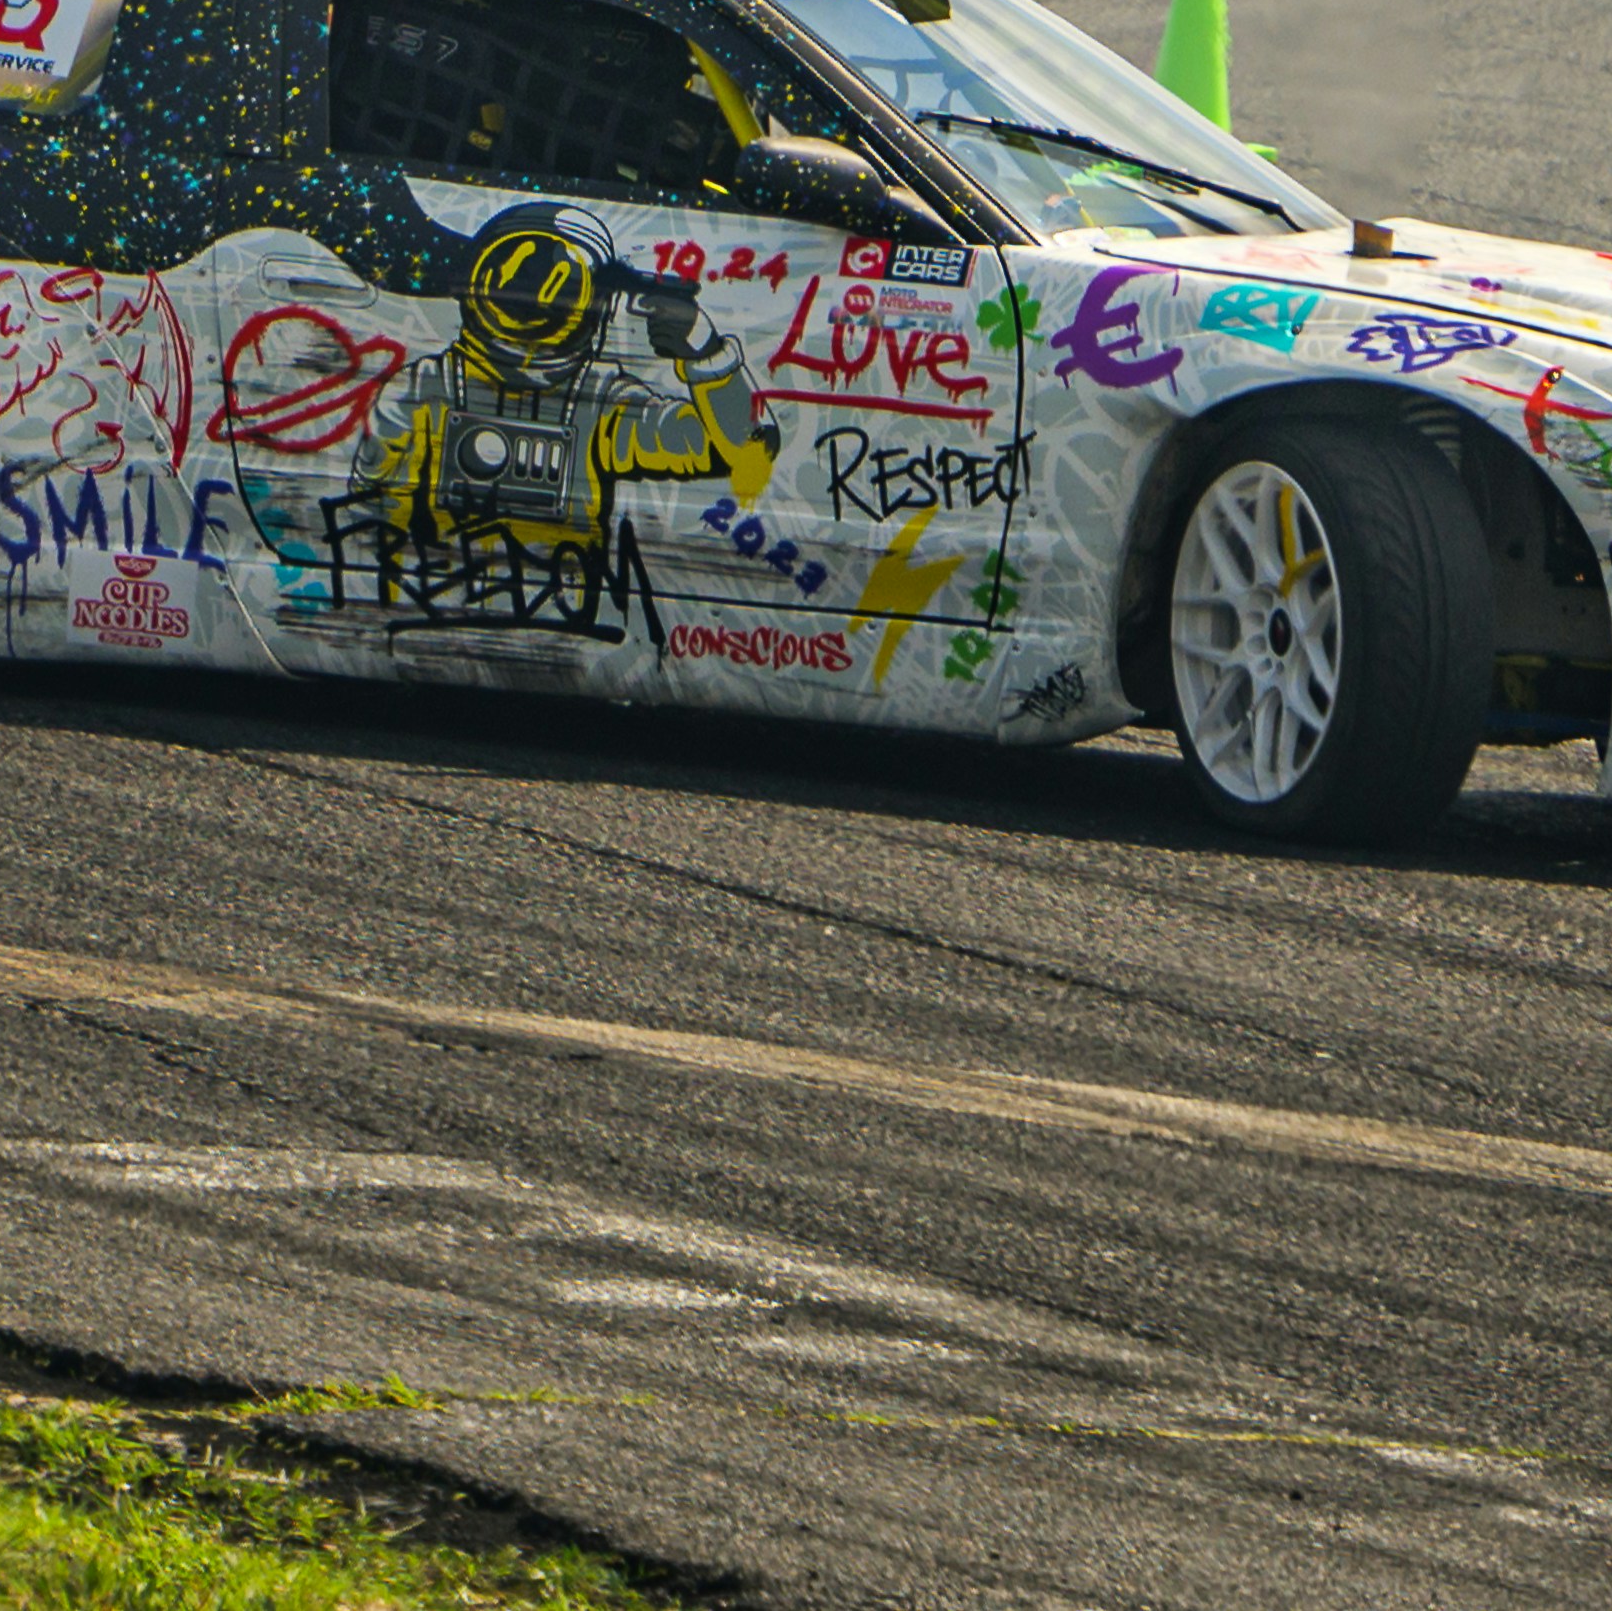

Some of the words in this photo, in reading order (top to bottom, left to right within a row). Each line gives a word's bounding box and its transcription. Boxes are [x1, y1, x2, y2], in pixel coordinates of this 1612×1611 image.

[653, 238, 788, 293] 10.24
[895, 244, 966, 265] INTER
[891, 261, 961, 282] CARS
[102, 577, 170, 610] CUP
[73, 598, 190, 638] NOODLES
